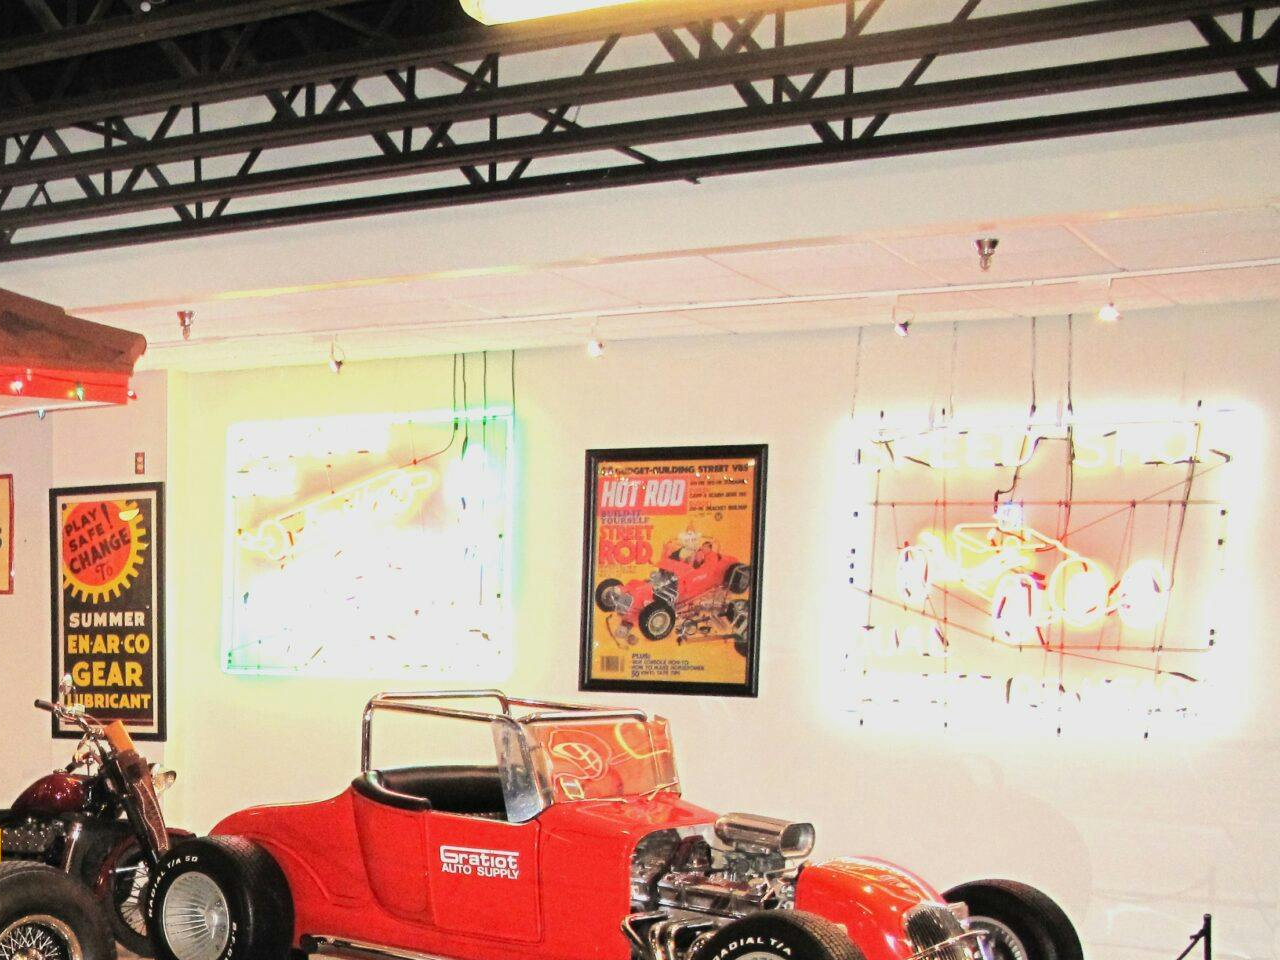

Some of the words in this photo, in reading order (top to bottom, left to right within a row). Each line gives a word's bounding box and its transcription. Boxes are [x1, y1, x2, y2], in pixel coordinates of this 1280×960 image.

[601, 480, 640, 508] HOT
[643, 479, 686, 507] ROD
[65, 509, 99, 536] PLAY
[70, 527, 131, 575] CHANGE
[599, 541, 654, 565] ROD
[95, 561, 113, 582] To
[69, 611, 145, 628] SUMMER
[72, 661, 143, 687] GEAR
[440, 845, 519, 869] Gratiot
[442, 863, 472, 875] AUTO
[477, 866, 519, 879] SUPPLY
[770, 938, 792, 956] T/A
